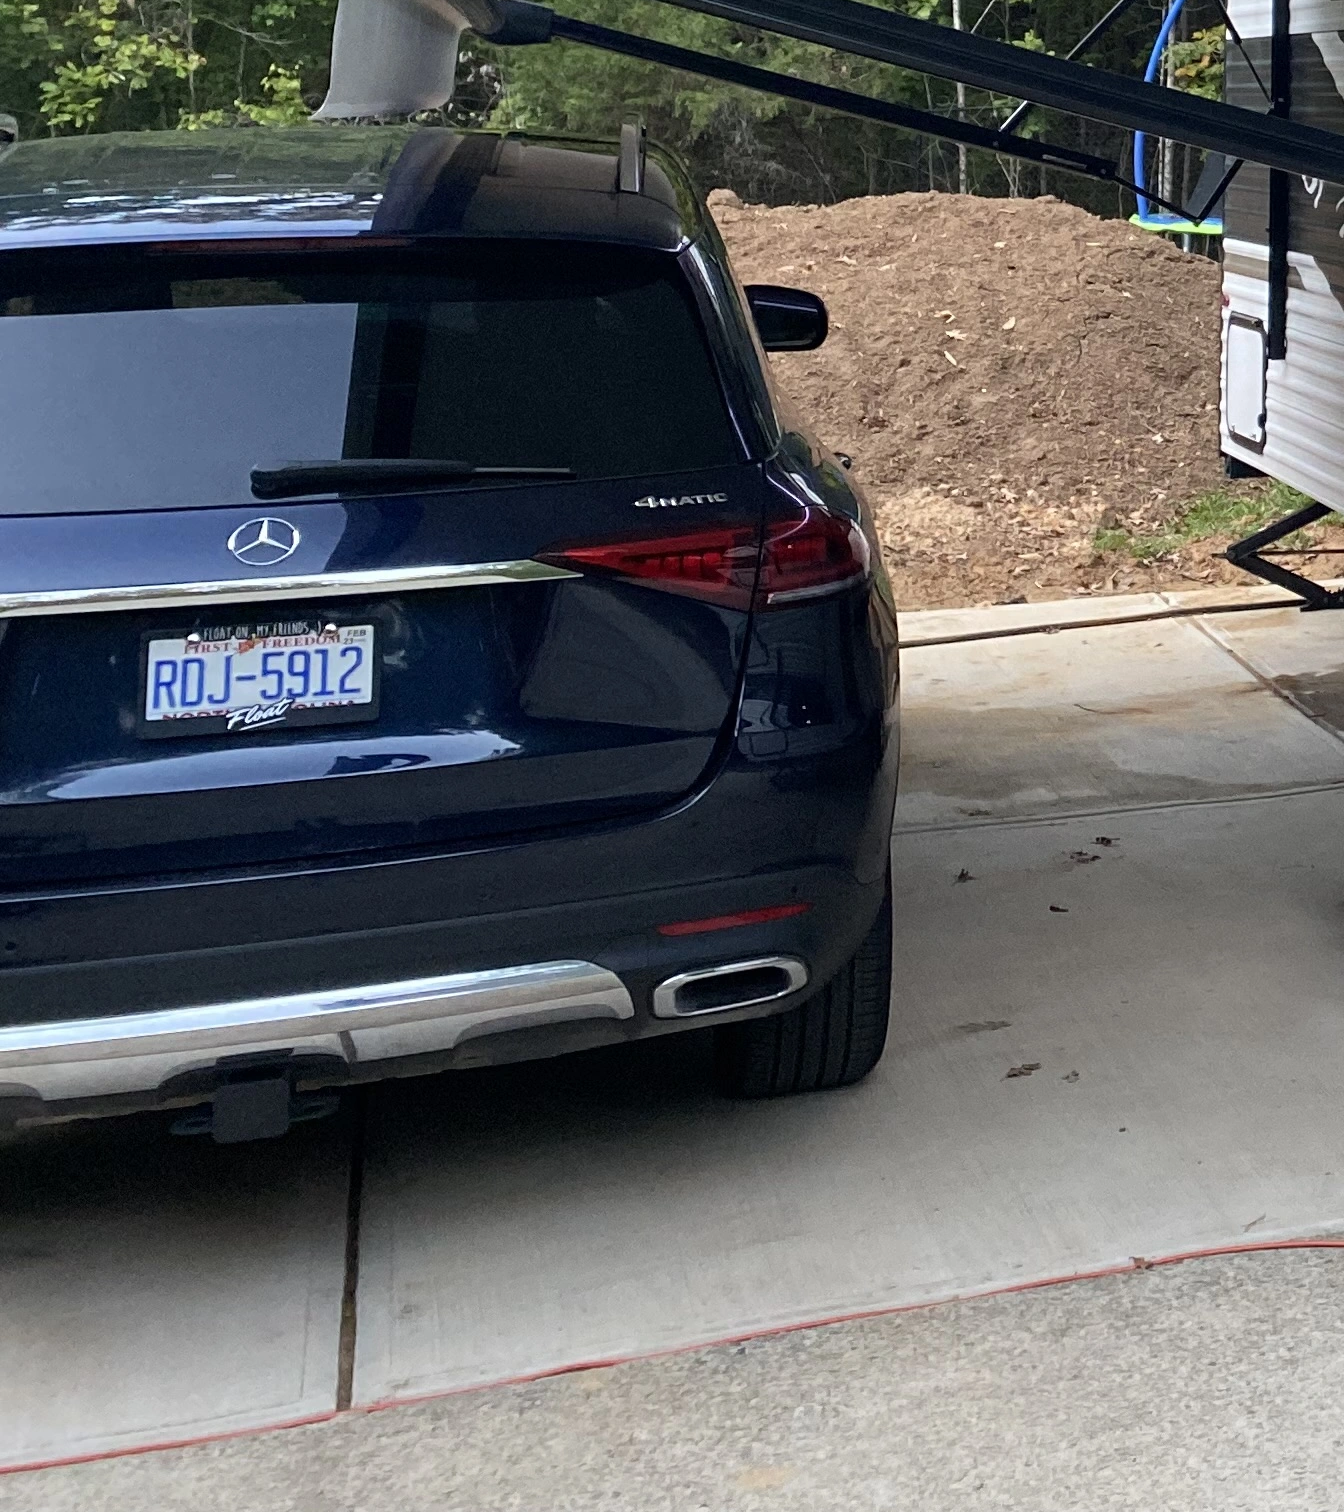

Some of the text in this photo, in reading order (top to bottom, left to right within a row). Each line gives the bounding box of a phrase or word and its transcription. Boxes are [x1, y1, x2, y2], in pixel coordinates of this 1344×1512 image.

[633, 492, 728, 508] 4MATIC
[203, 626, 232, 641] FLOAT
[256, 624, 269, 637] MY
[272, 621, 309, 636] FRIENDS
[346, 629, 366, 637] FEB
[262, 633, 340, 649] FREEDOM
[151, 645, 364, 710] RDJ-5912
[227, 697, 294, 730] Float
